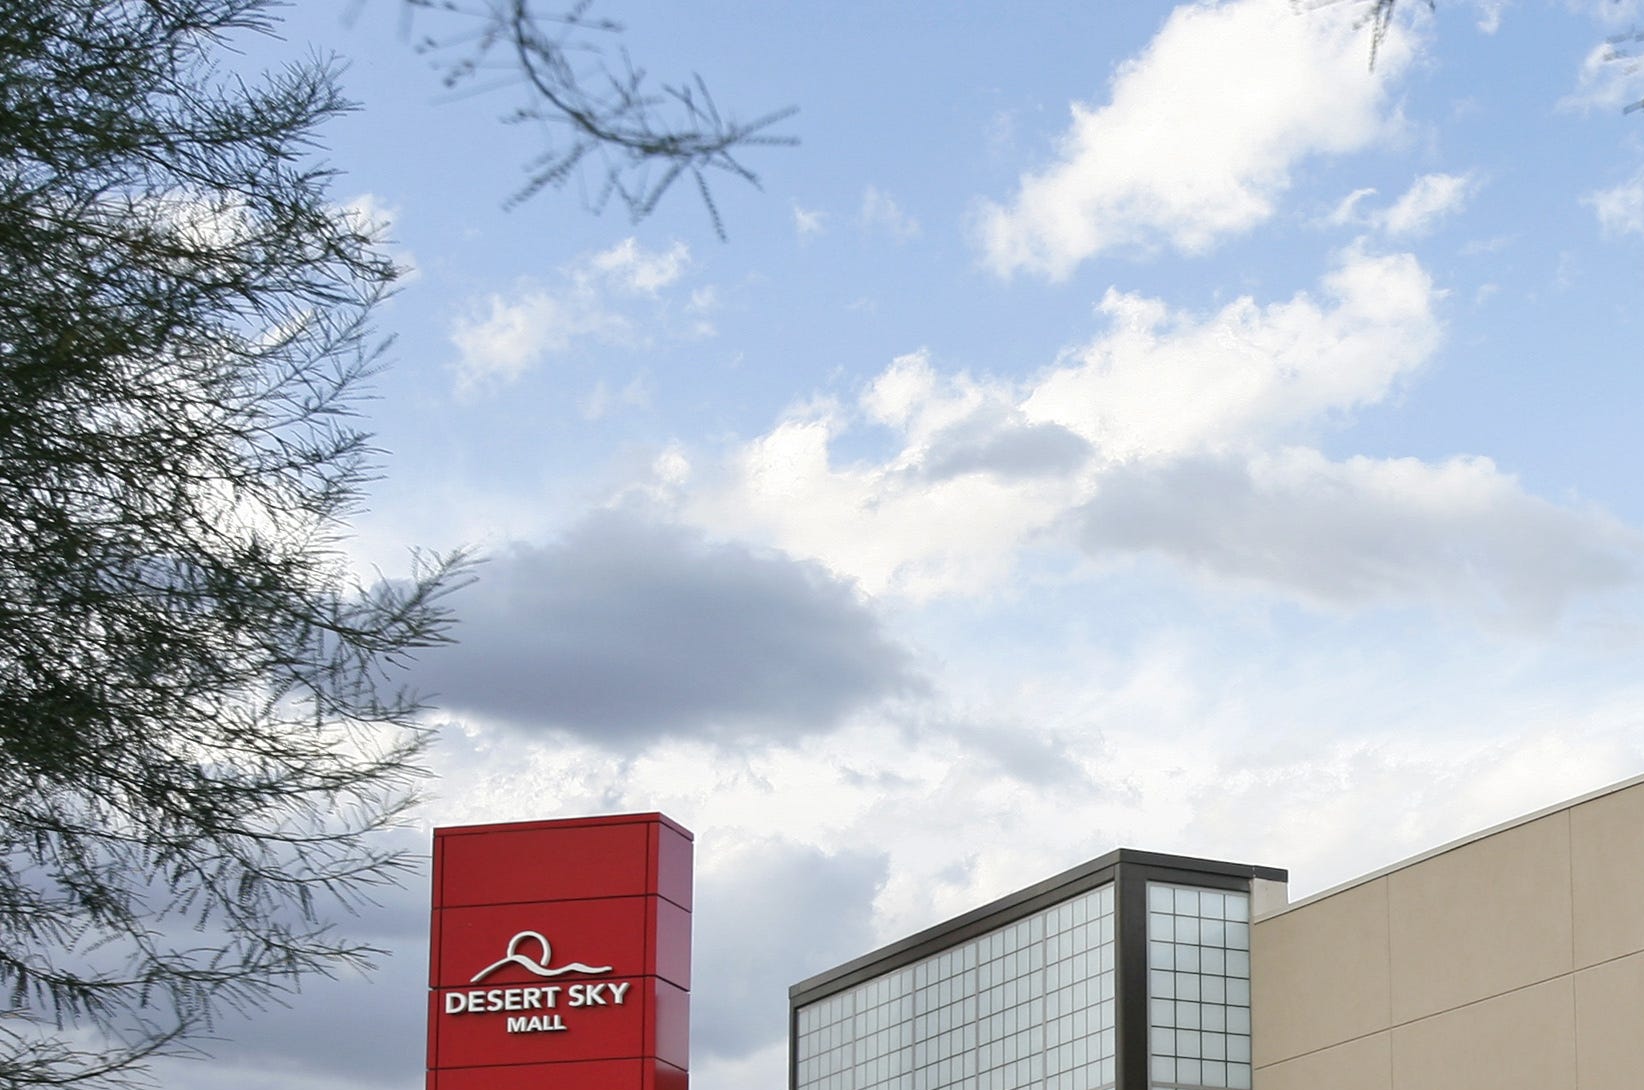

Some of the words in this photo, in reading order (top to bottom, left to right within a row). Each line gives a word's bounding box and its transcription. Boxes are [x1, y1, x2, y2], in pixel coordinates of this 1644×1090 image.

[445, 986, 562, 1014] DESERT
[568, 982, 630, 1007] SKY
[507, 1014, 567, 1033] MALL
